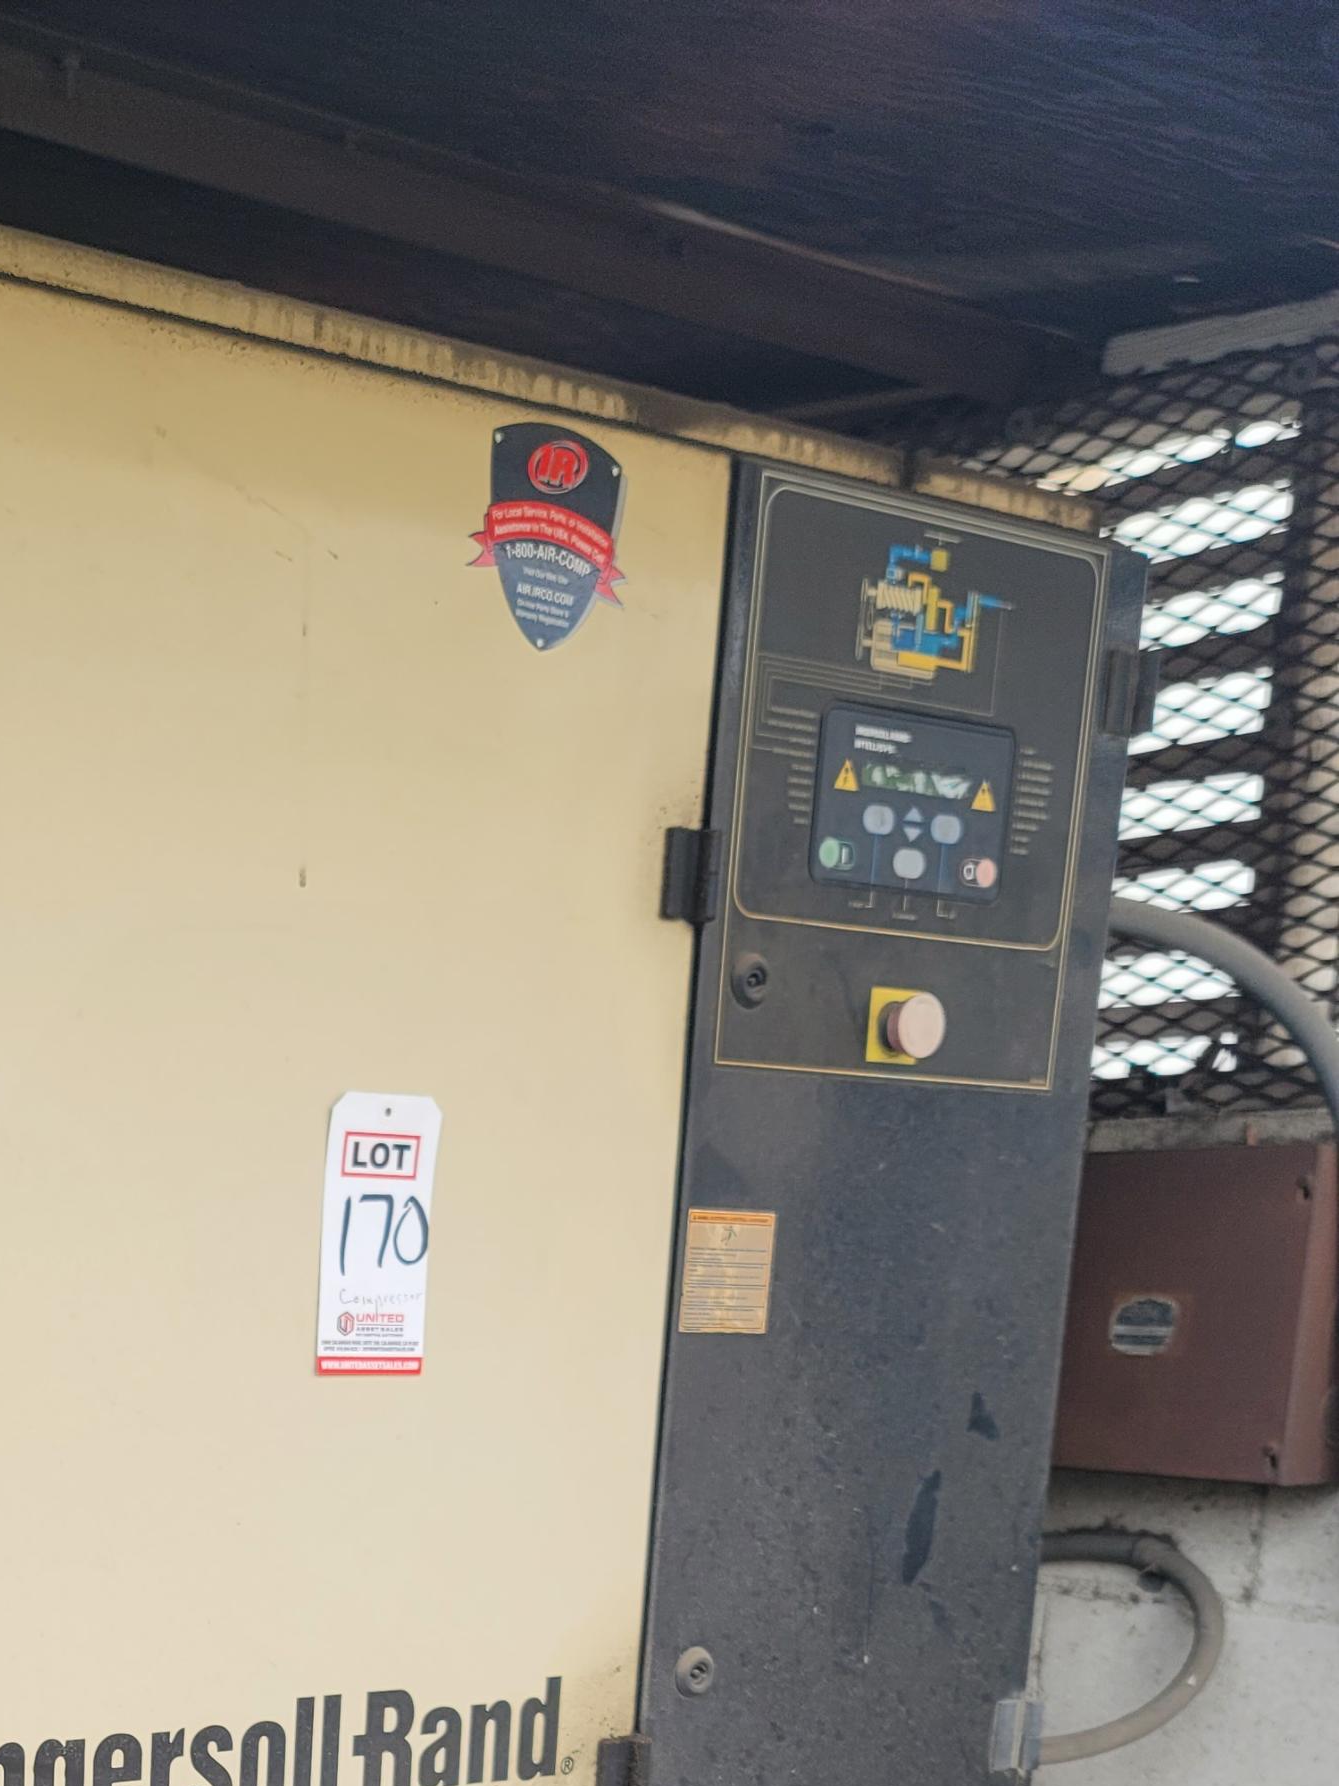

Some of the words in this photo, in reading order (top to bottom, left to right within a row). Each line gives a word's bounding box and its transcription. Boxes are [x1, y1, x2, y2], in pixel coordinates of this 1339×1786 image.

[505, 541, 591, 578] 1-800-AIR-COMP
[351, 1141, 412, 1170] LOT
[339, 1194, 429, 1276] 170
[356, 1312, 404, 1323] UNITED
